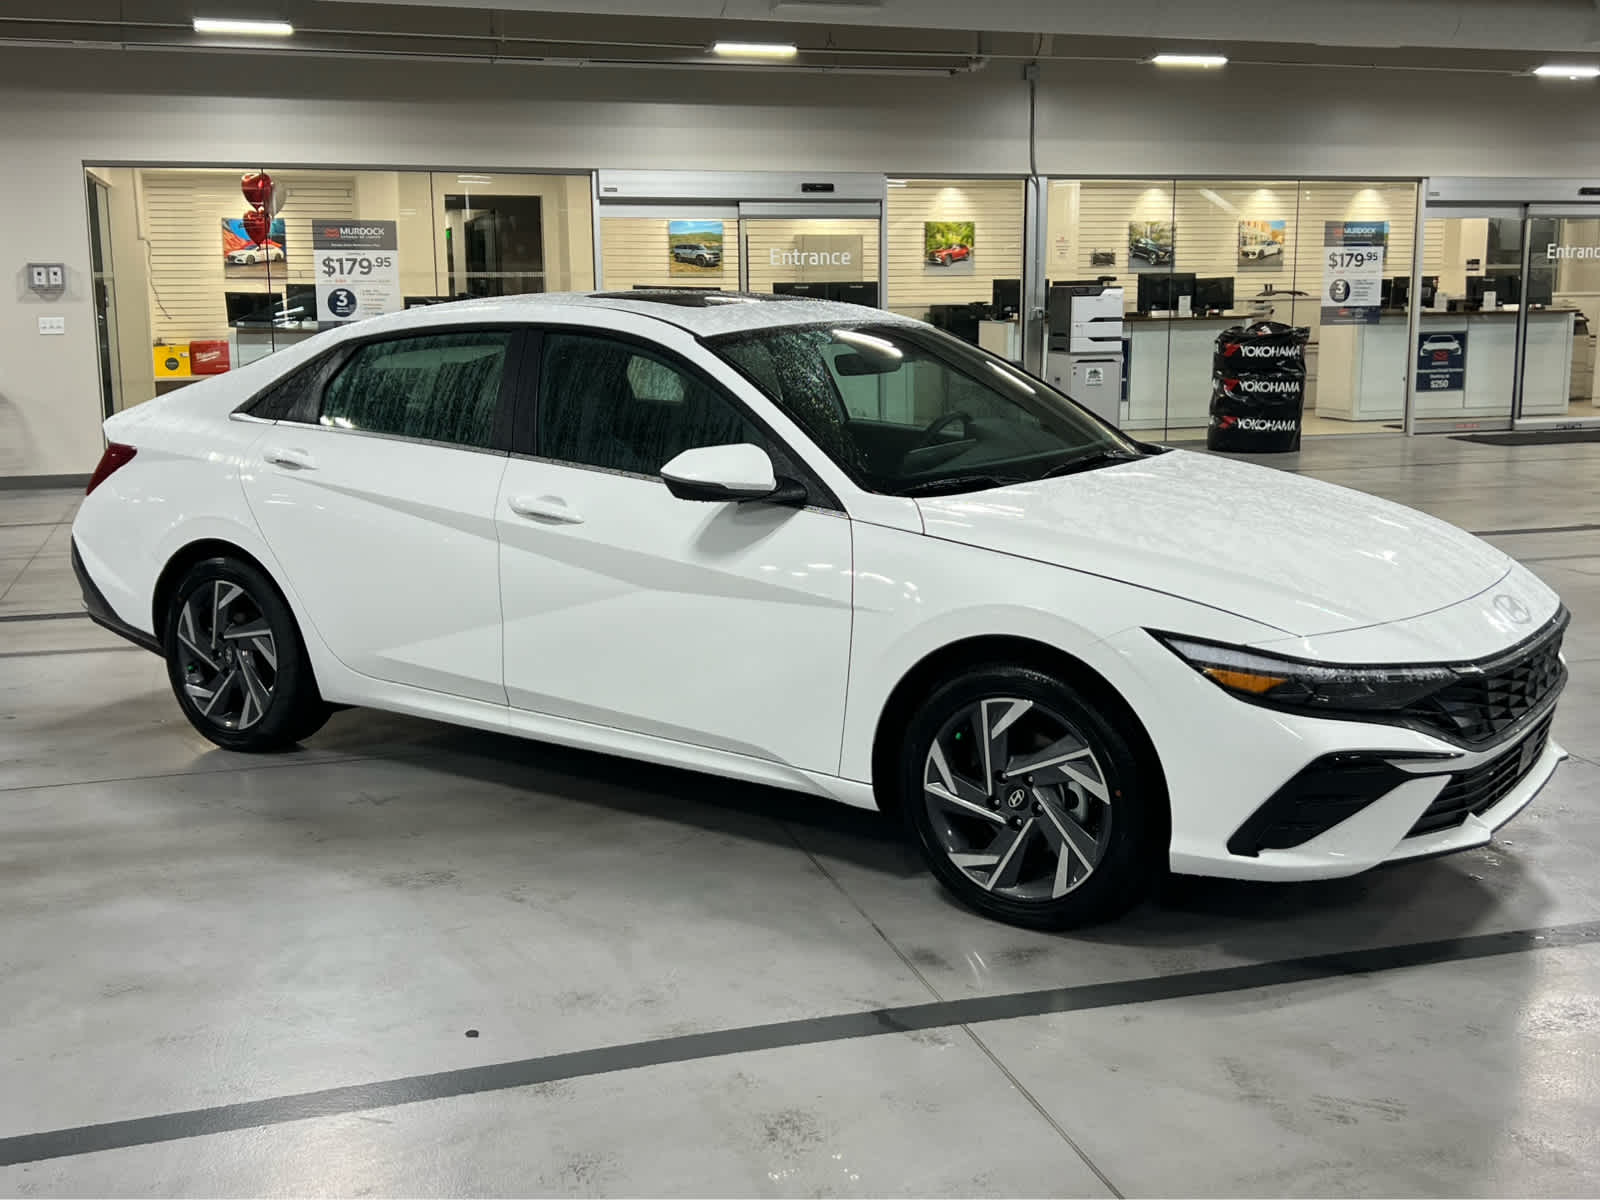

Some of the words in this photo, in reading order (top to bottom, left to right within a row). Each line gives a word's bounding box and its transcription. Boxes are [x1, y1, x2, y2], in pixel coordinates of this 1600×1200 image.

[340, 227, 385, 236] MURDOCK
[769, 248, 851, 265] Entrance
[321, 256, 392, 277] $179.95
[1335, 281, 1344, 293] 3
[336, 291, 348, 306] 3
[1240, 345, 1300, 357] YOKOHAMA
[1239, 381, 1300, 393] YOKOHAMA
[1237, 418, 1296, 431] YOKOHAMA
